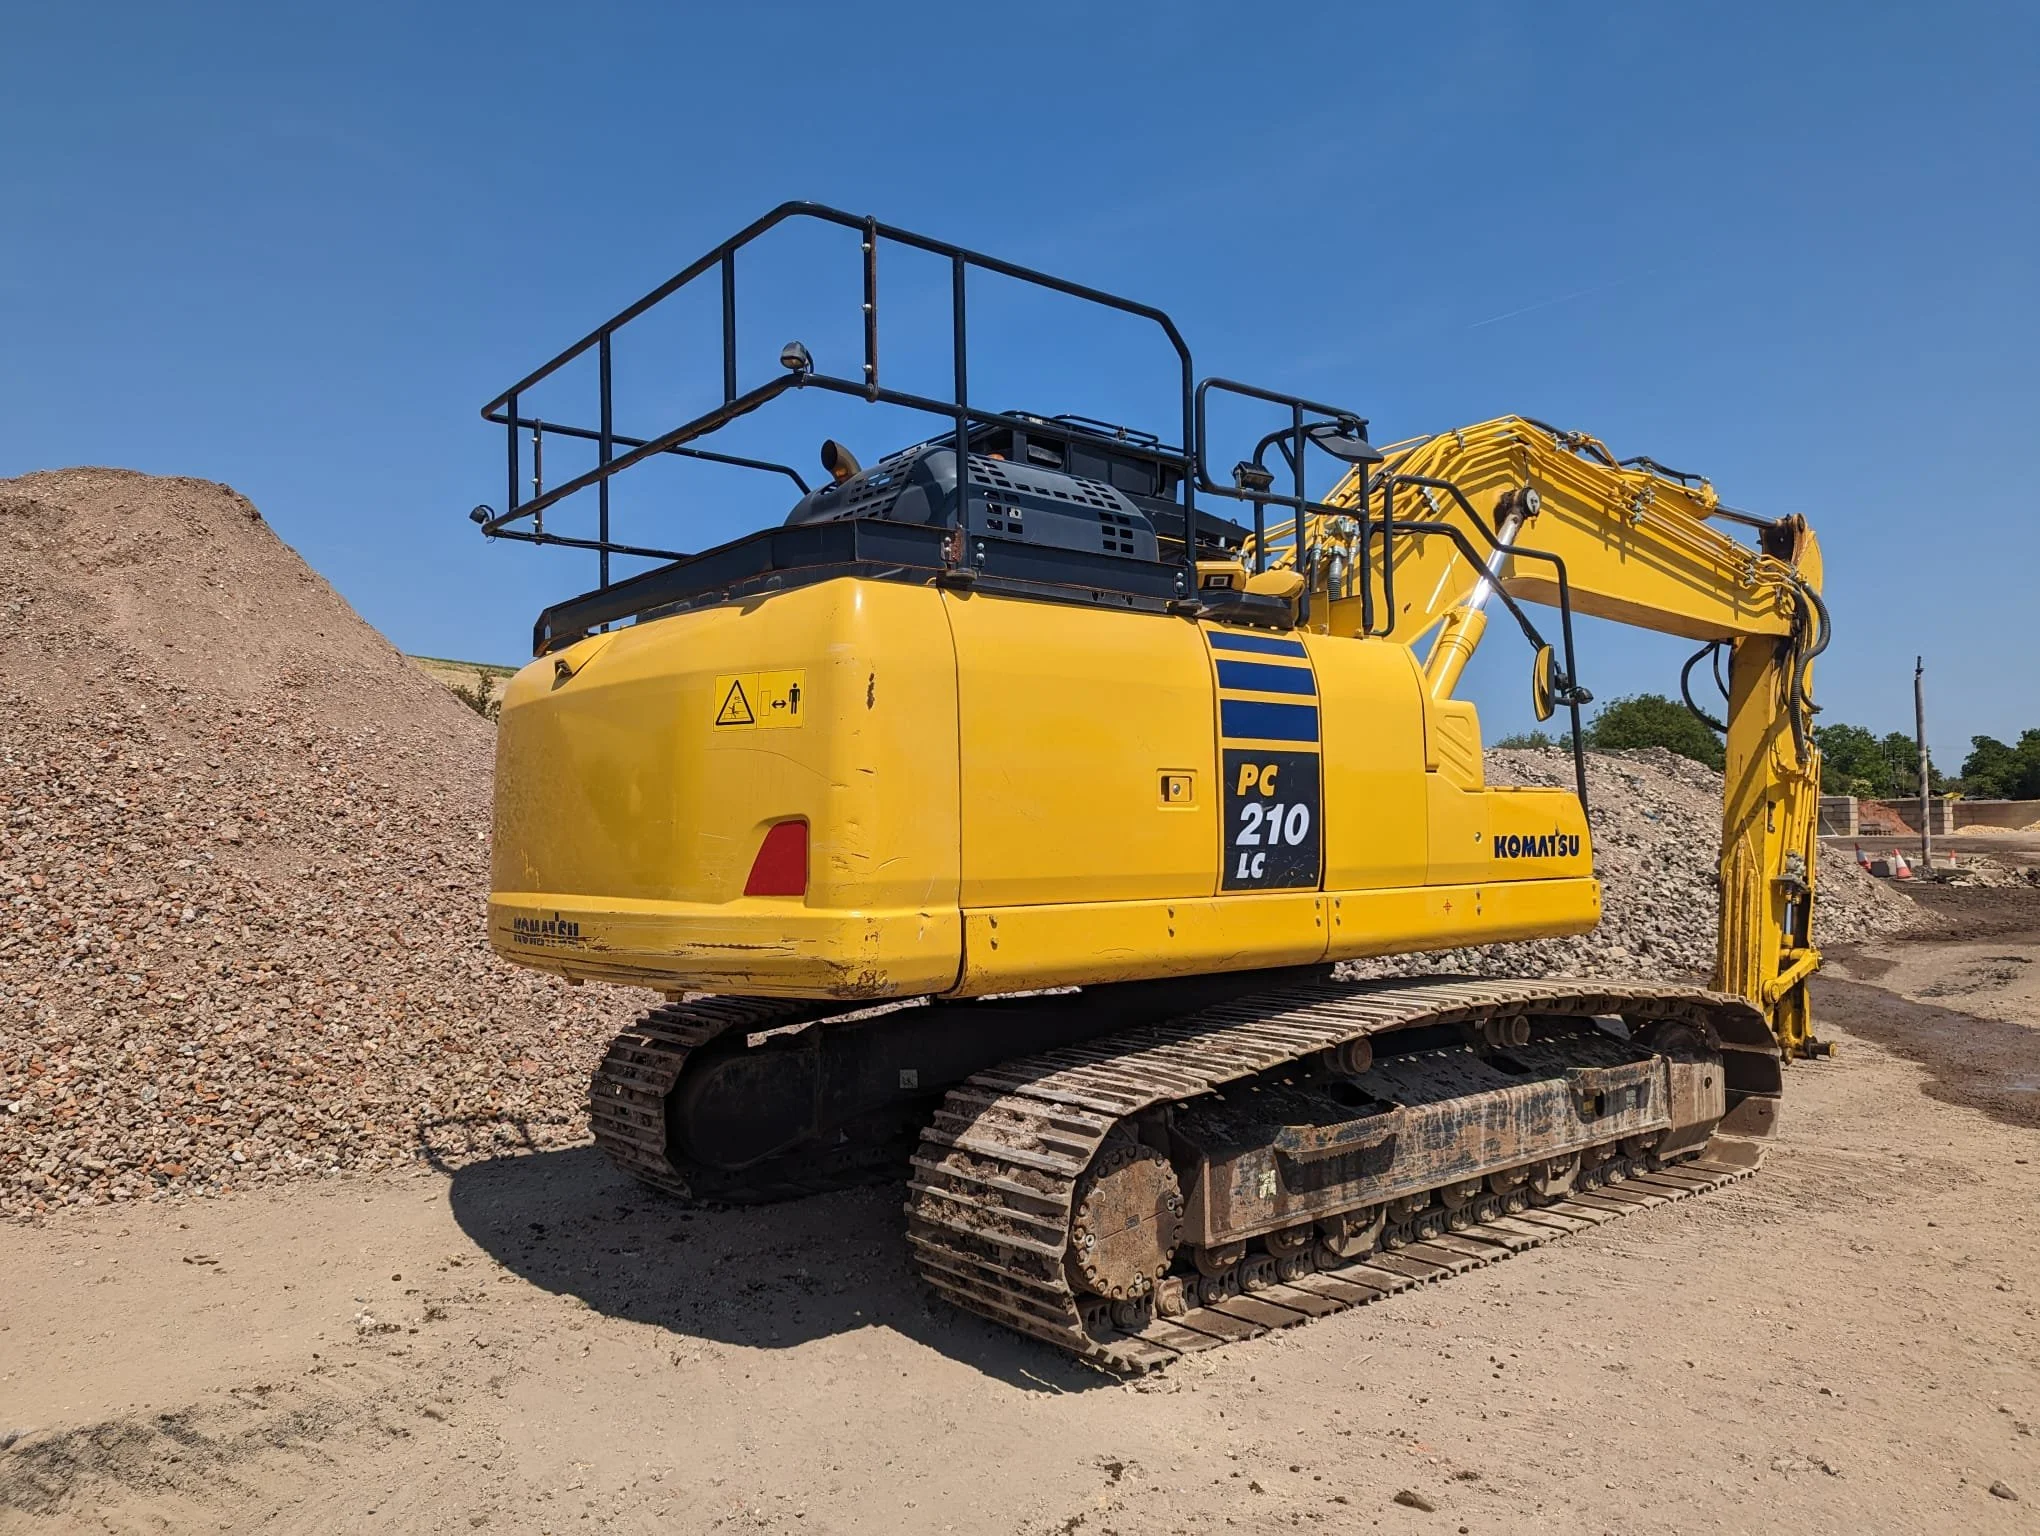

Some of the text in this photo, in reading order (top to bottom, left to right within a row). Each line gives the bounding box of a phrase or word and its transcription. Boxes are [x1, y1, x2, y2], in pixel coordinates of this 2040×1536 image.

[1236, 763, 1279, 797] PC
[1235, 802, 1310, 846] 210
[1493, 829, 1580, 859] KOMATSU
[1236, 852, 1266, 879] LC
